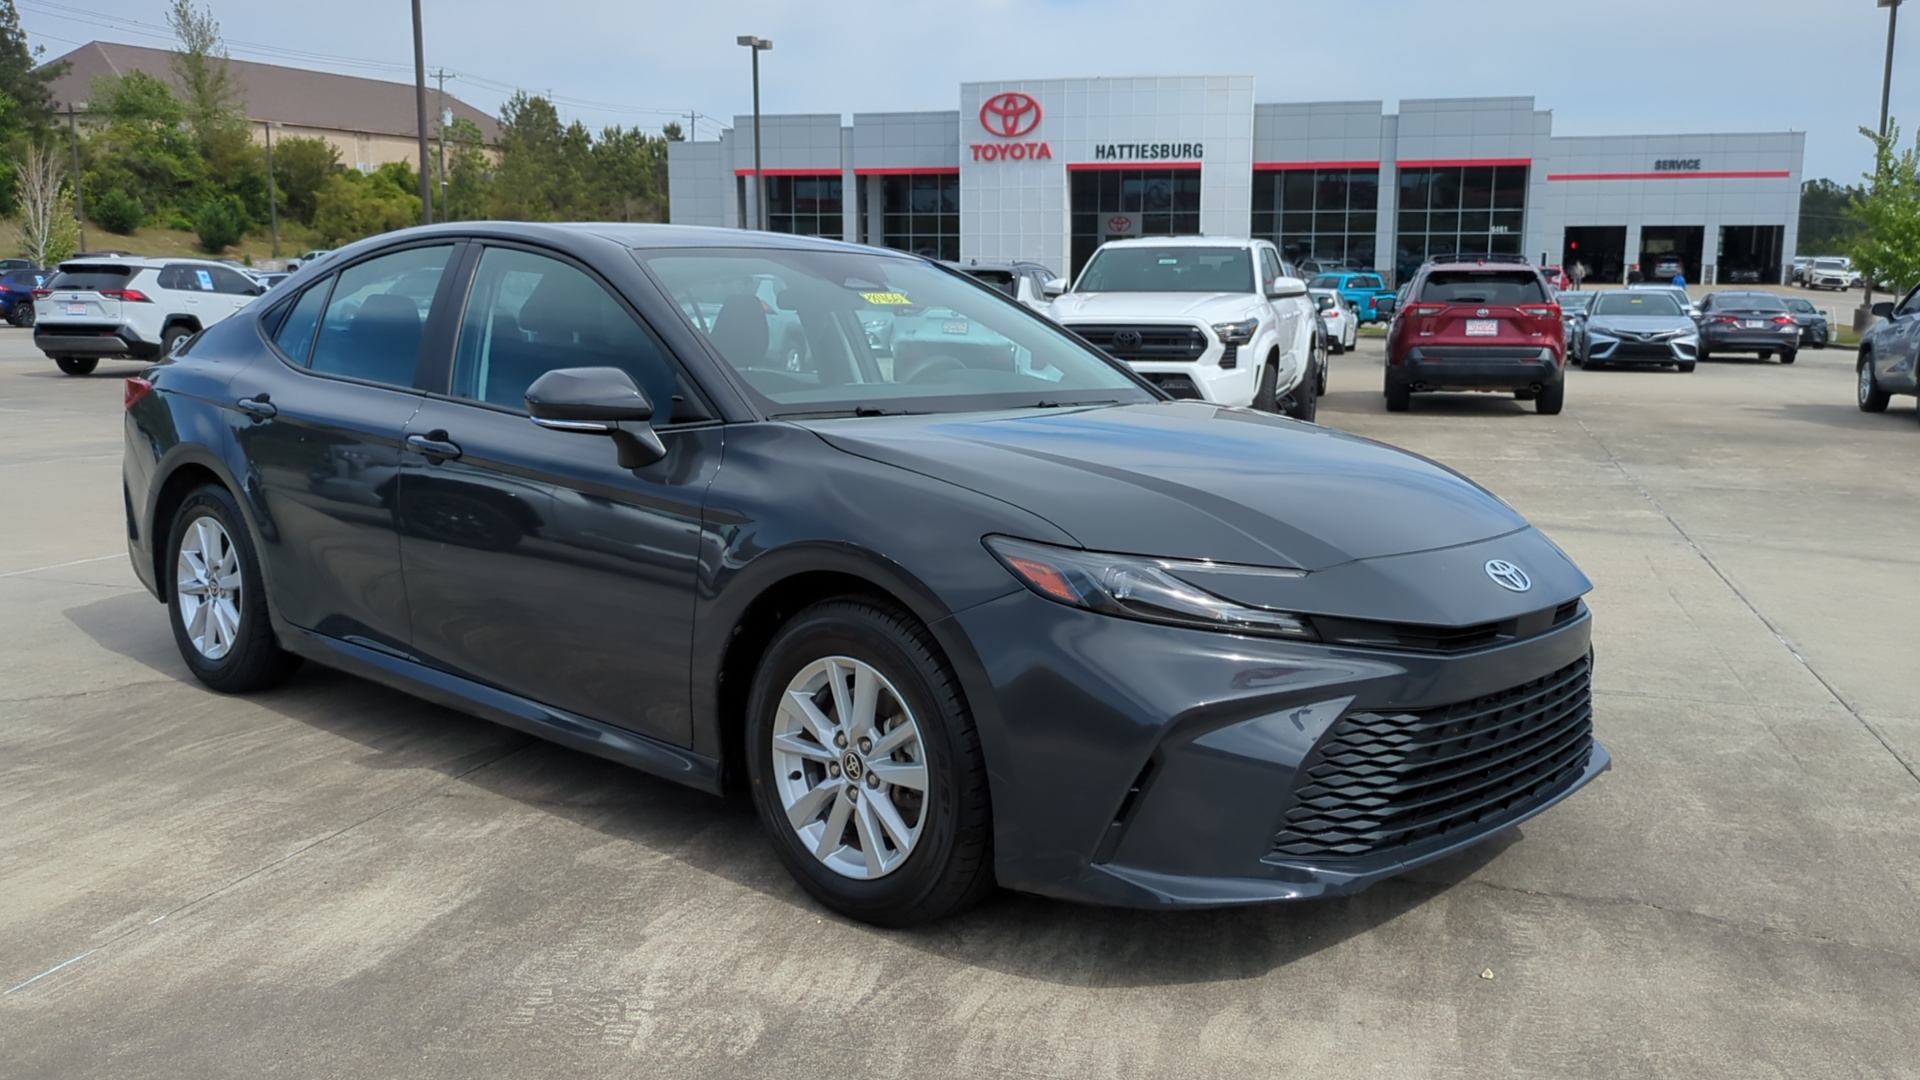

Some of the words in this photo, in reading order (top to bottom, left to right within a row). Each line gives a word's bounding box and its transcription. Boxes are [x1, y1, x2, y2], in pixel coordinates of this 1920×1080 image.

[970, 142, 1052, 162] TOYOTA
[1095, 143, 1203, 160] HATTIESBURG
[1655, 159, 1701, 170] SERVICE
